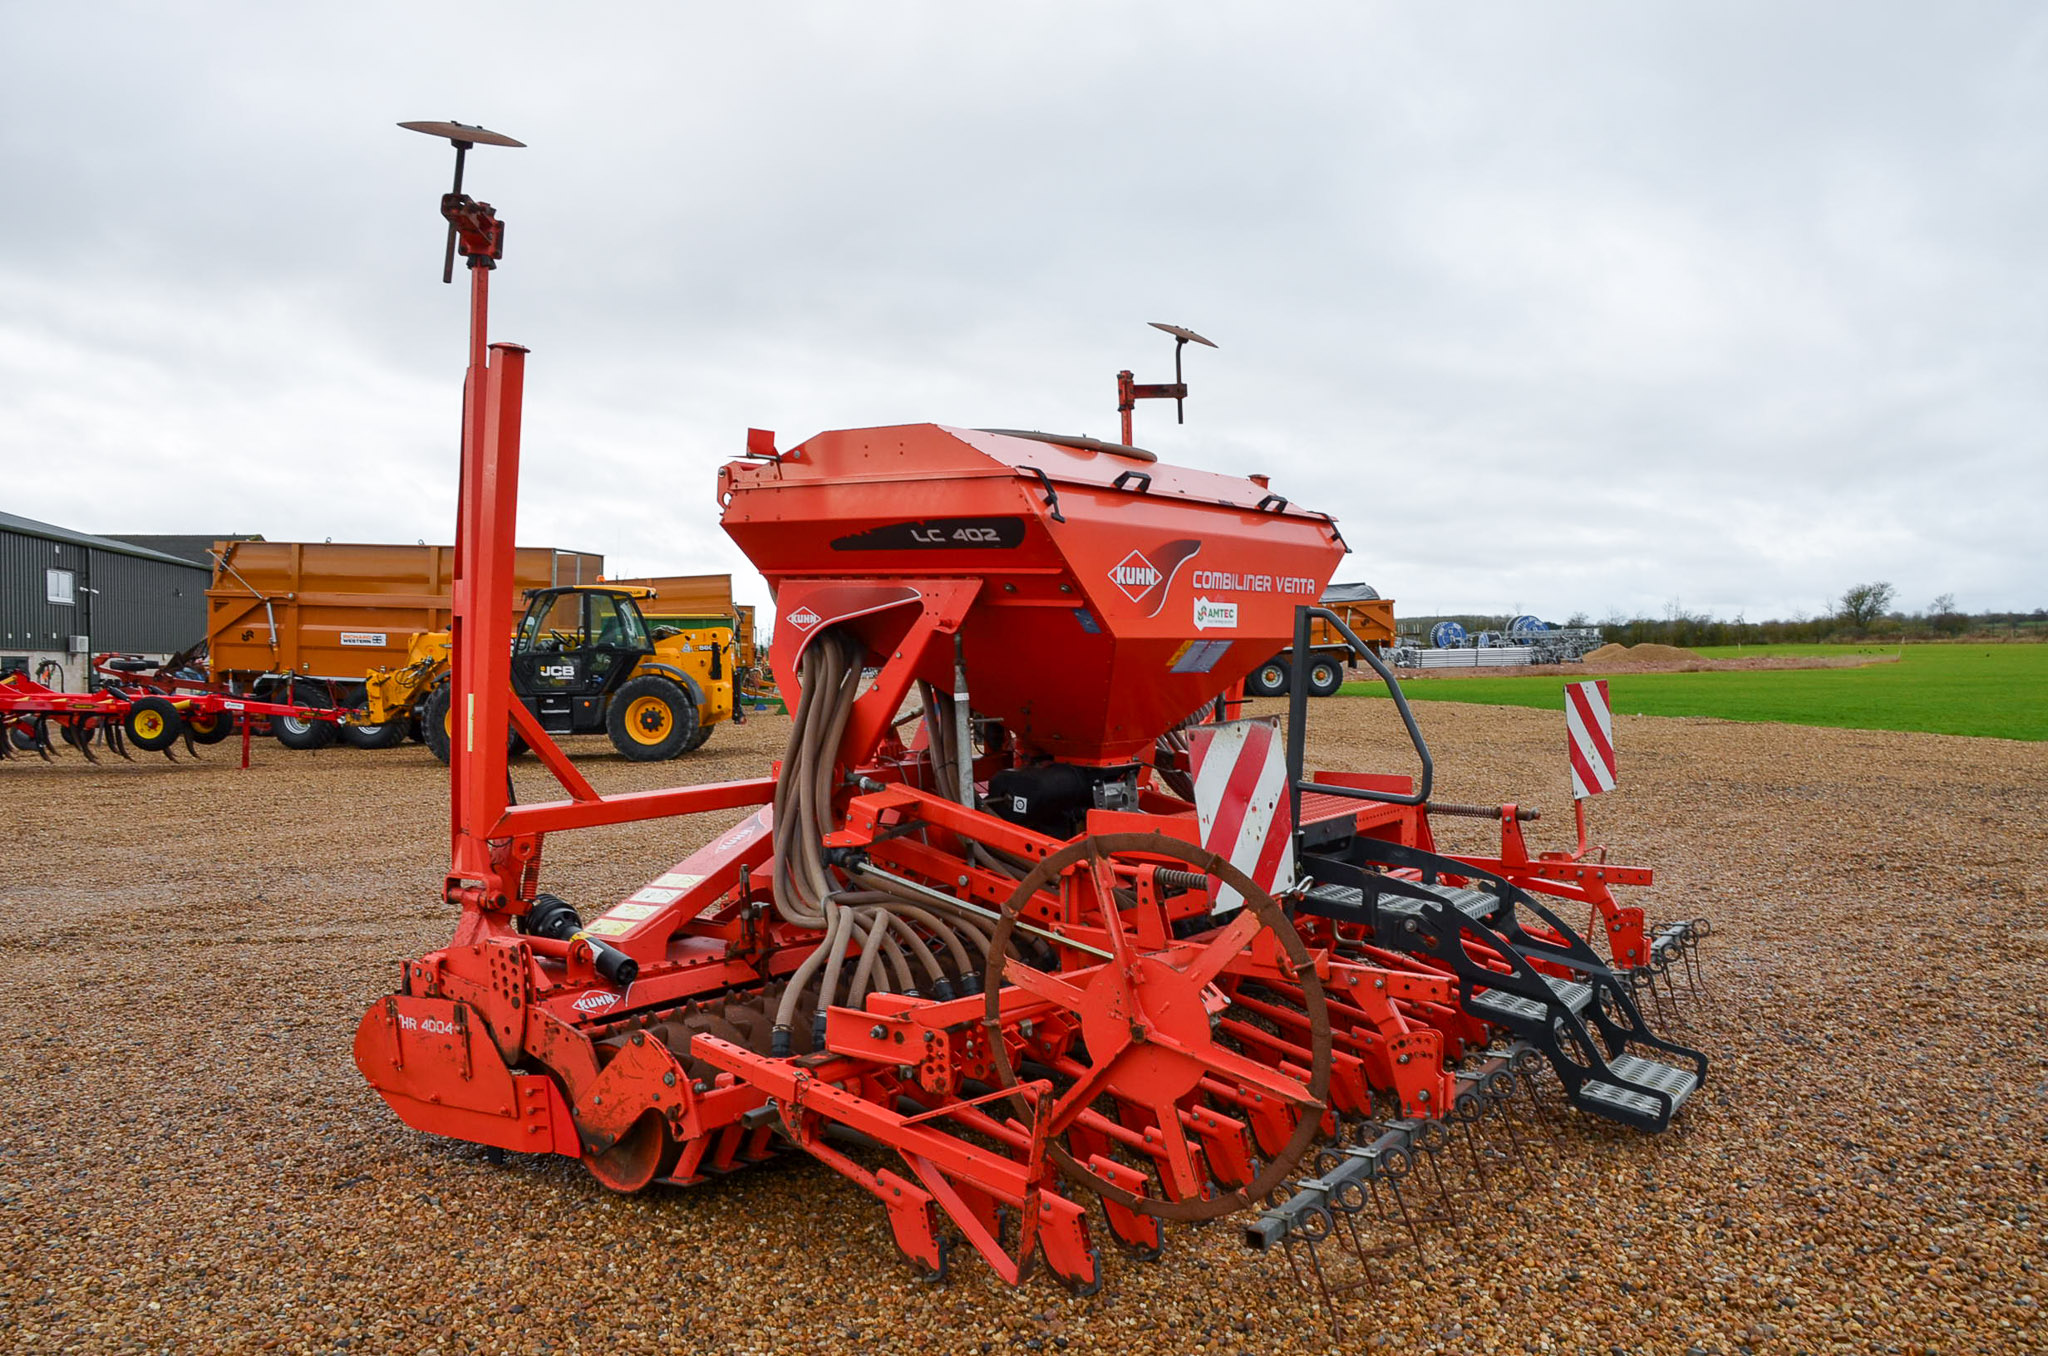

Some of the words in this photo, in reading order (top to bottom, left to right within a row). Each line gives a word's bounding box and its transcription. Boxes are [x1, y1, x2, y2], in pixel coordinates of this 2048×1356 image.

[910, 529, 946, 543] LC
[952, 528, 1001, 542] 402
[1116, 566, 1155, 586] KUHN
[1193, 571, 1272, 592] COMBILINER
[1276, 577, 1316, 595] VENTA
[791, 614, 817, 624] KUHN
[1207, 608, 1234, 619] AMTEC
[540, 665, 575, 677] JCB
[578, 993, 616, 1011] KUHN
[401, 1016, 417, 1031] HR
[421, 1019, 453, 1035] 4004
